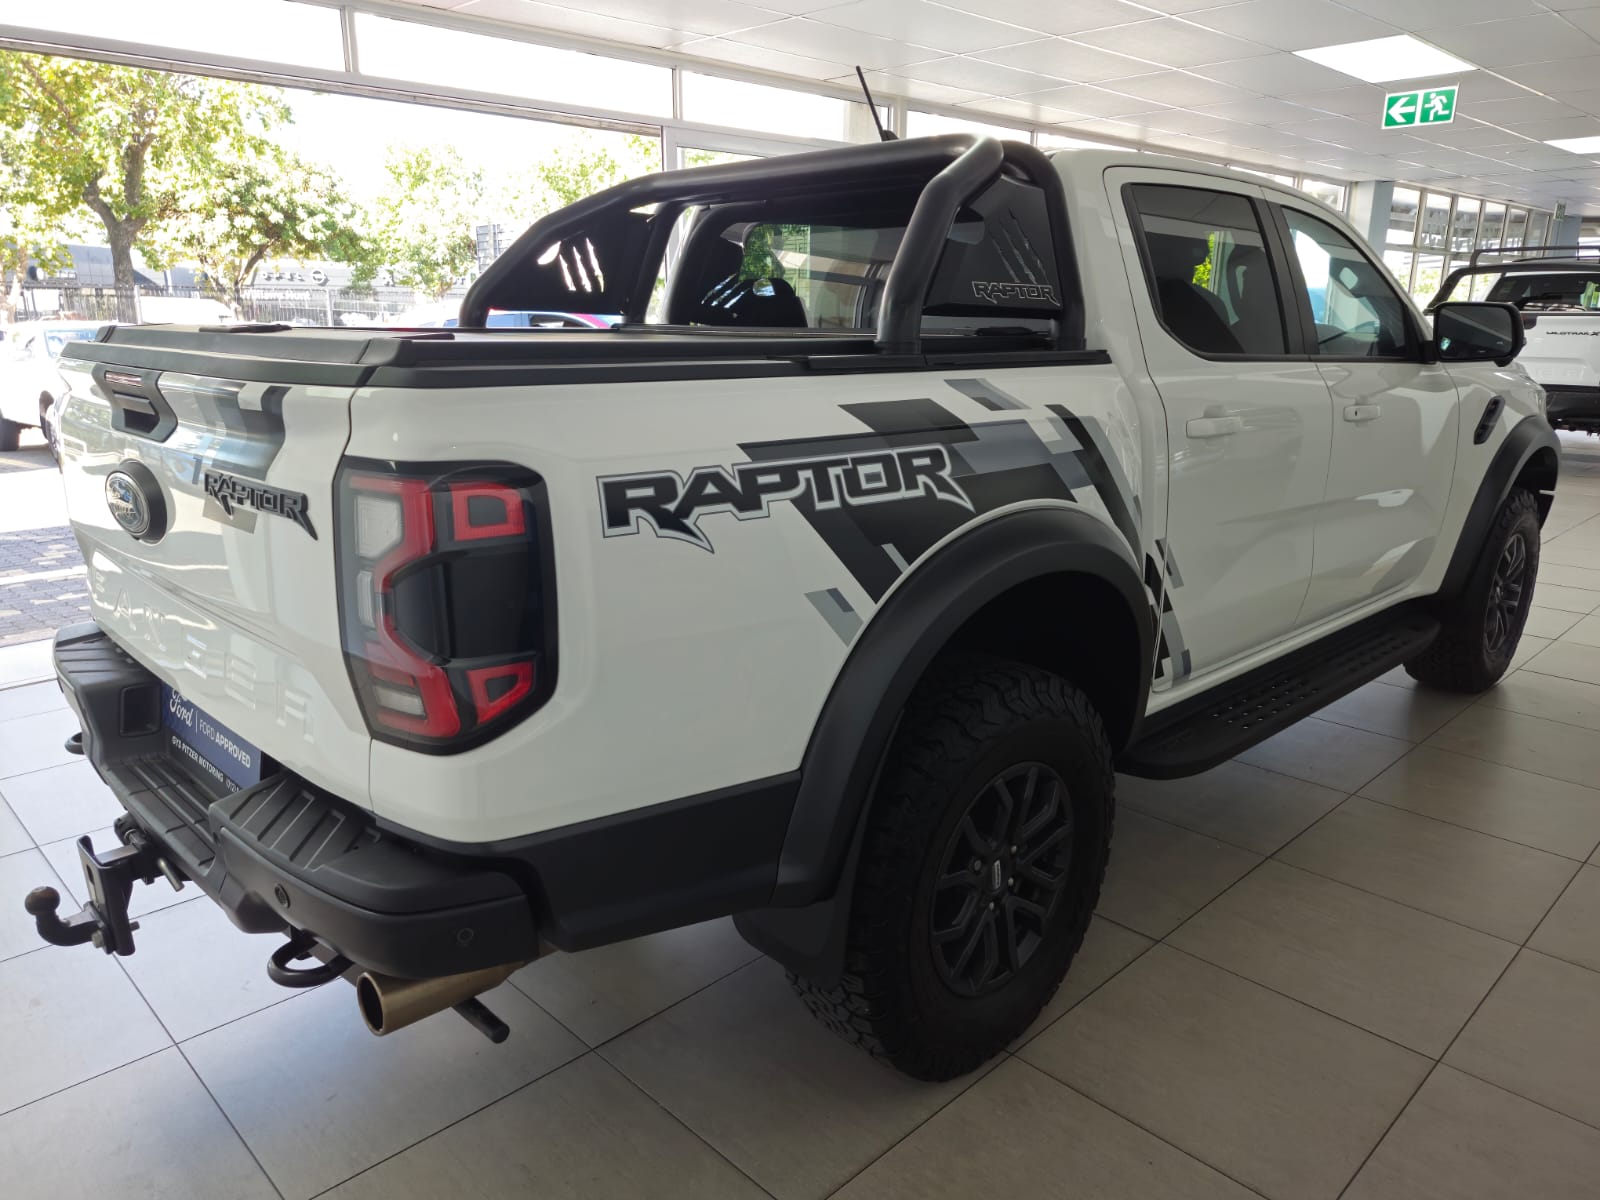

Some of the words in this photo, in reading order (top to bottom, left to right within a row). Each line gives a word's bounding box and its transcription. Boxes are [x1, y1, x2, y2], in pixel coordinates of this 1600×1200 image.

[971, 280, 1060, 306] RAPTOR
[203, 467, 318, 541] RAPTOR
[596, 442, 976, 554] RAPTOR
[169, 687, 194, 728] Ford
[199, 718, 216, 741] FORD
[215, 731, 251, 769] APPROVED
[181, 742, 199, 763] PITZER
[198, 755, 224, 783] MOTORING
